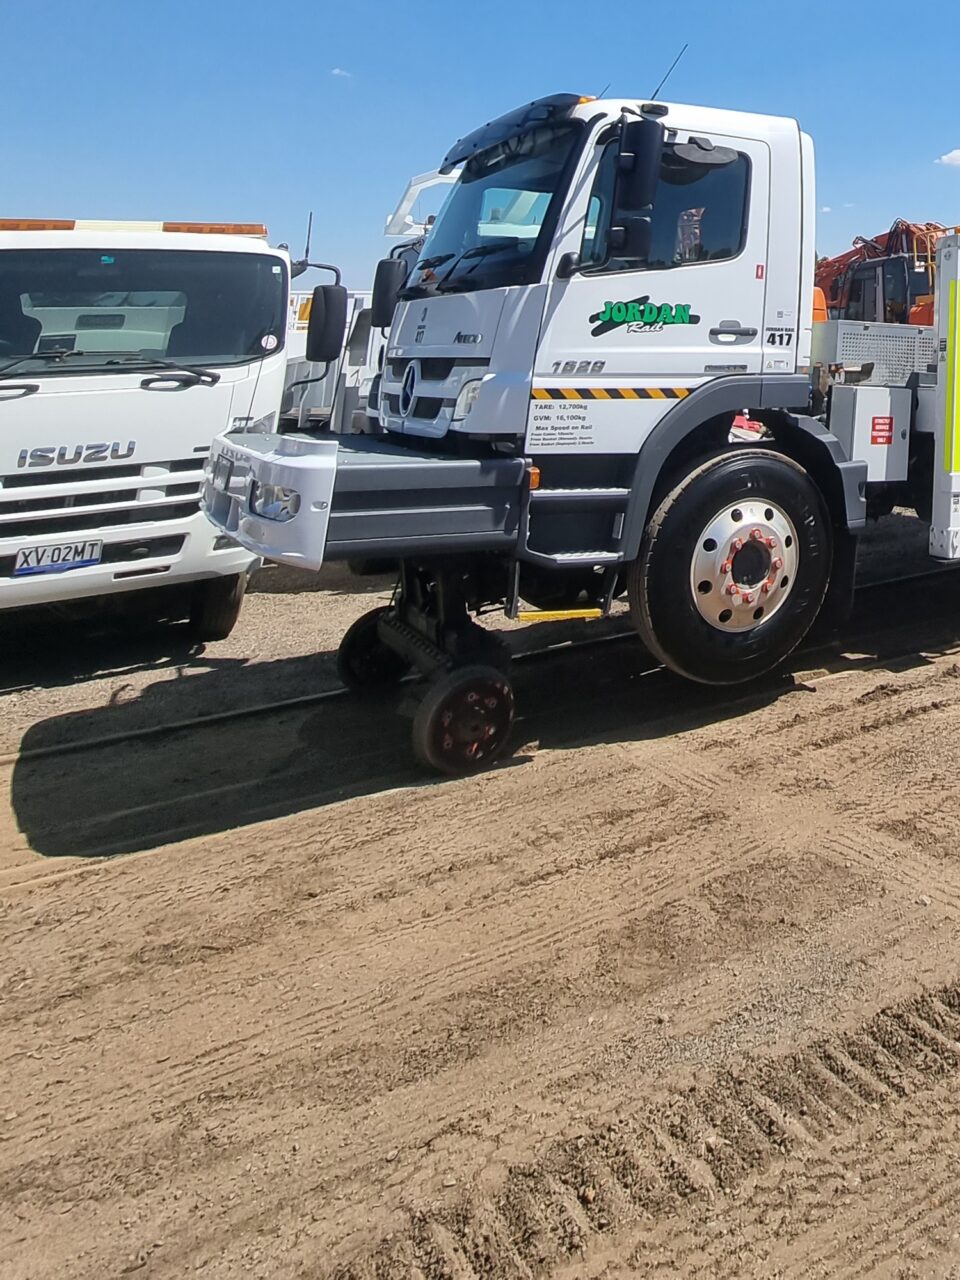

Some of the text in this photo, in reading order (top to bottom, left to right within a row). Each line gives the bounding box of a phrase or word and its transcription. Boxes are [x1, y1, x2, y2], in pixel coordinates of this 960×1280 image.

[599, 301, 691, 323] JORDAN
[627, 321, 663, 333] Rail
[767, 332, 793, 346] 417
[17, 440, 136, 468] ISUZU
